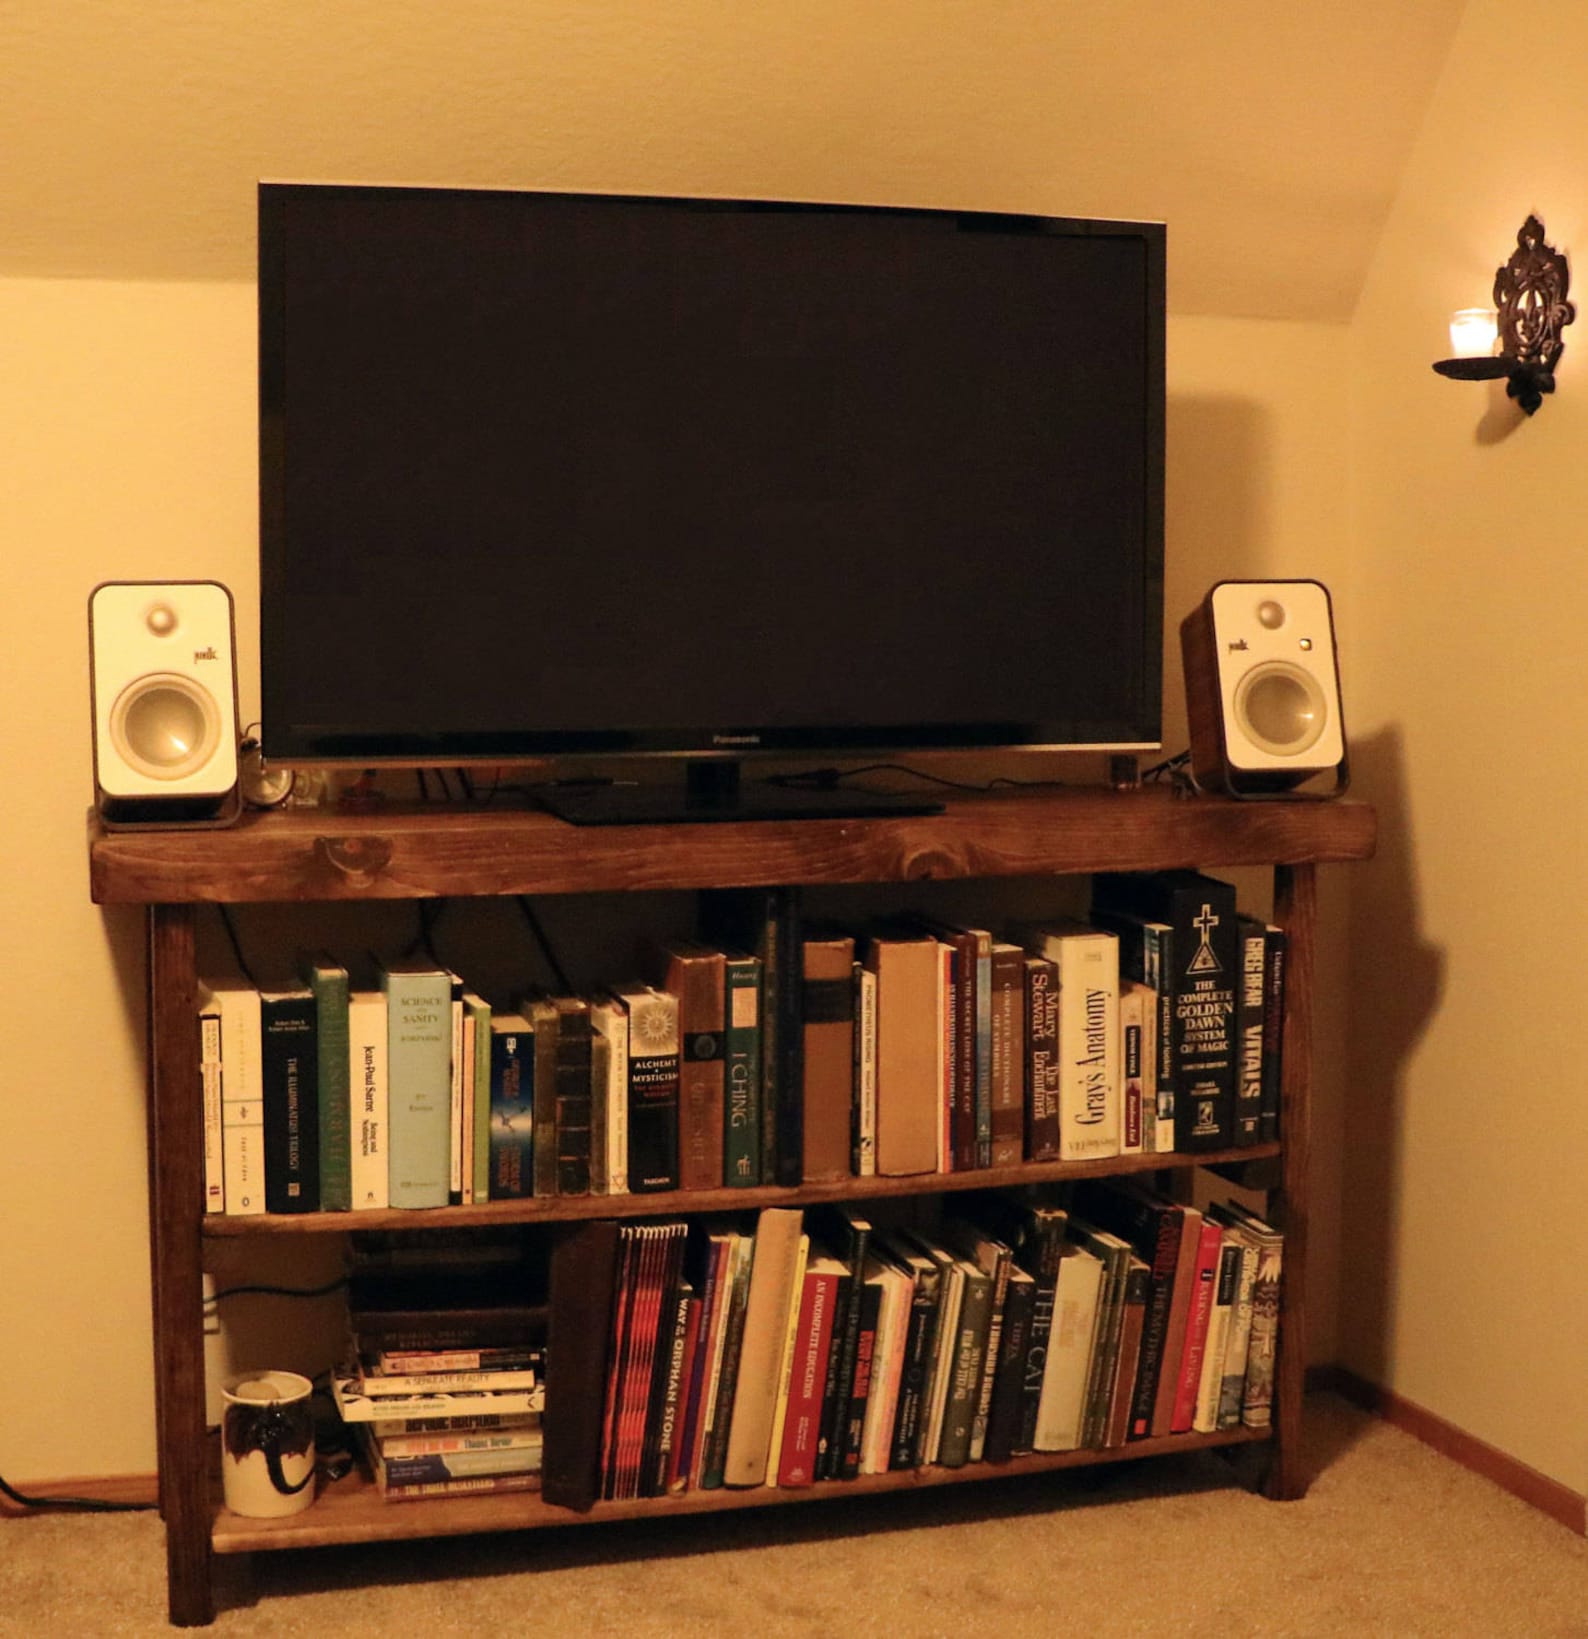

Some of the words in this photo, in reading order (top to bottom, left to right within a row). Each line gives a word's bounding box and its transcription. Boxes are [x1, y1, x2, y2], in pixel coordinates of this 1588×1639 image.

[1244, 937, 1265, 973] GREG
[1177, 991, 1233, 1004] COMPLETE
[1194, 980, 1217, 991] THE
[1243, 973, 1264, 1007] BEAR
[402, 1012, 440, 1023] SANITY
[1032, 974, 1049, 1041] Stewart
[1044, 991, 1059, 1038] Mary
[1161, 996, 1173, 1036] practices
[1176, 1001, 1234, 1019] GOLDEN
[1184, 1015, 1225, 1031] DAWN
[1075, 987, 1112, 1068] Anatomy
[1184, 1029, 1225, 1042] SYSTEM
[634, 1059, 677, 1070] ALCHEMY
[1160, 1046, 1173, 1079] looking
[1180, 1043, 1195, 1054] OF
[1197, 1040, 1230, 1053] MAGIC
[1239, 1024, 1264, 1099] VITALS
[362, 1045, 377, 1085] Jean-Paul
[631, 1072, 679, 1083] MYSTICISM
[1046, 1065, 1059, 1085] The
[364, 1086, 377, 1113] Sartre
[730, 1063, 748, 1128] CHING
[1033, 1050, 1050, 1121] Enchantment
[1046, 1089, 1059, 1115] Last
[1073, 1072, 1112, 1126] Gray's
[816, 1279, 826, 1293] AN
[1152, 1286, 1168, 1310] THE
[1195, 1269, 1215, 1326] TRADING
[675, 1298, 689, 1323] WAY
[808, 1294, 824, 1348] INCOMPLETE
[1030, 1288, 1055, 1337] THE
[802, 1350, 818, 1399] EDUCATION
[1023, 1345, 1046, 1392] CAT
[1184, 1345, 1201, 1389] LIVING
[660, 1406, 677, 1453] STONE
